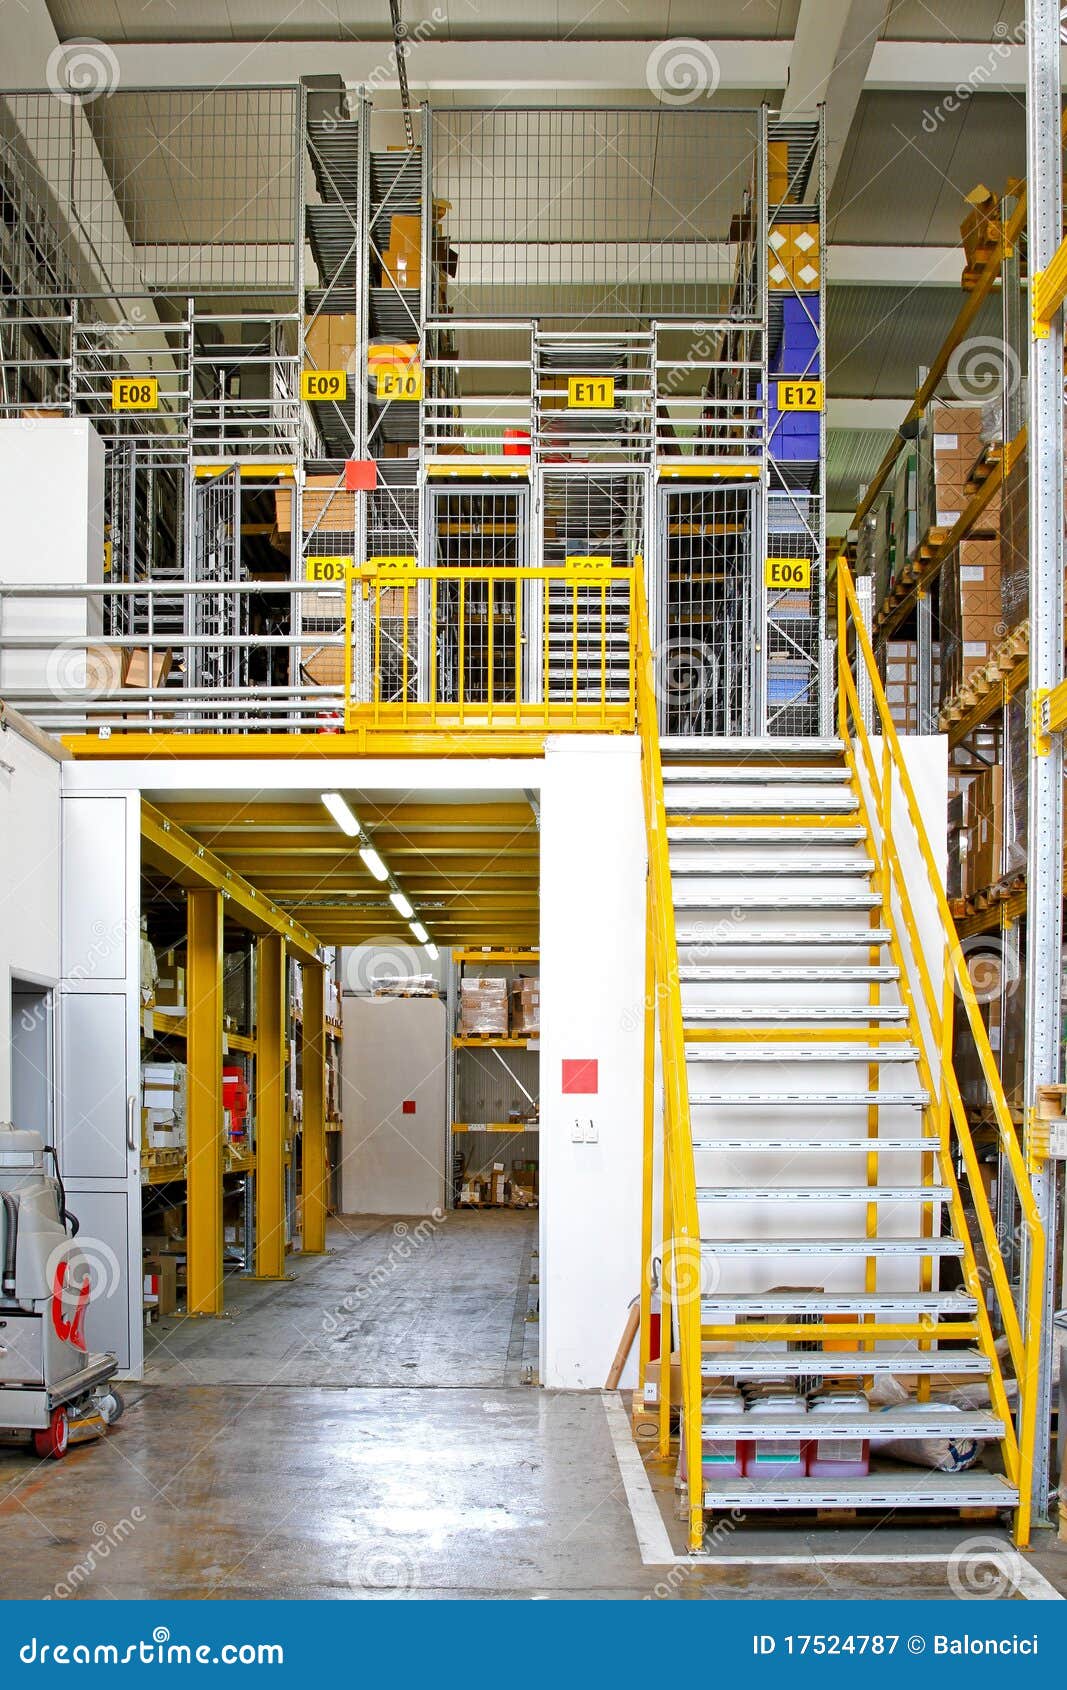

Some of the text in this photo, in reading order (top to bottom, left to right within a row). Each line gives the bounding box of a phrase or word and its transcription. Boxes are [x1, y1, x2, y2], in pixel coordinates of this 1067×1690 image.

[119, 385, 151, 403] E08
[307, 376, 340, 394] E09
[384, 376, 417, 394] E10
[575, 384, 607, 402] E11
[784, 387, 817, 406] E12
[313, 562, 345, 581] E03
[771, 563, 804, 582] E06
